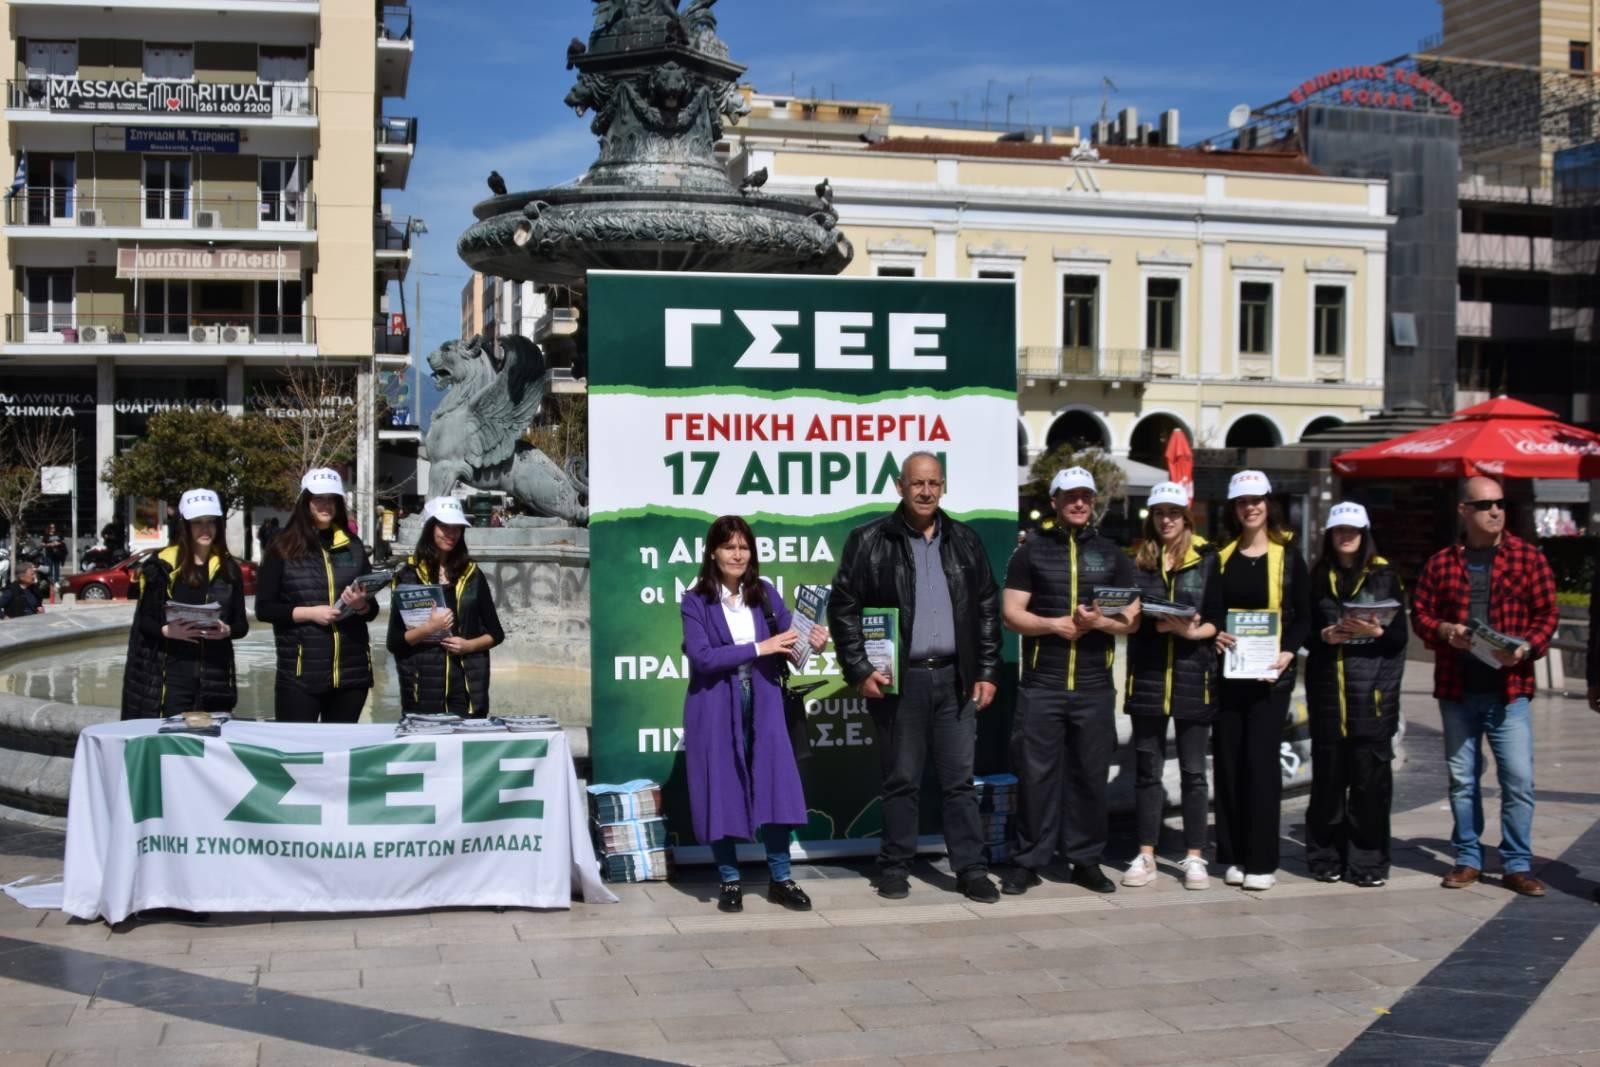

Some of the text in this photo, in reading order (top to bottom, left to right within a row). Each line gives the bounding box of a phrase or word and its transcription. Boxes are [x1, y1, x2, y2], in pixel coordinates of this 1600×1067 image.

[51, 80, 271, 101] MASSAGE RITUAL
[199, 102, 271, 113] 261 600 2200
[220, 252, 287, 269] ΓΡΑΦΕΙΟ
[665, 308, 947, 370] ΓΣΕΕ
[5, 405, 75, 417] ΧΗΜΙΚΑ
[664, 413, 951, 442] ΓΕΝΙΚΗ ΑΠΕΡΓΙΑ
[663, 451, 720, 496] 17
[639, 546, 659, 569] η
[640, 586, 665, 604] οι
[124, 735, 549, 825] ΓΣΕΕ
[137, 834, 542, 859] ΓΕΝΙΚΗ ΣΥΝΟΜΟΣΠΟΝΔΙΑ ΕΡΓΑΤΩΝ ΕΛΛΑΔΑΣ
